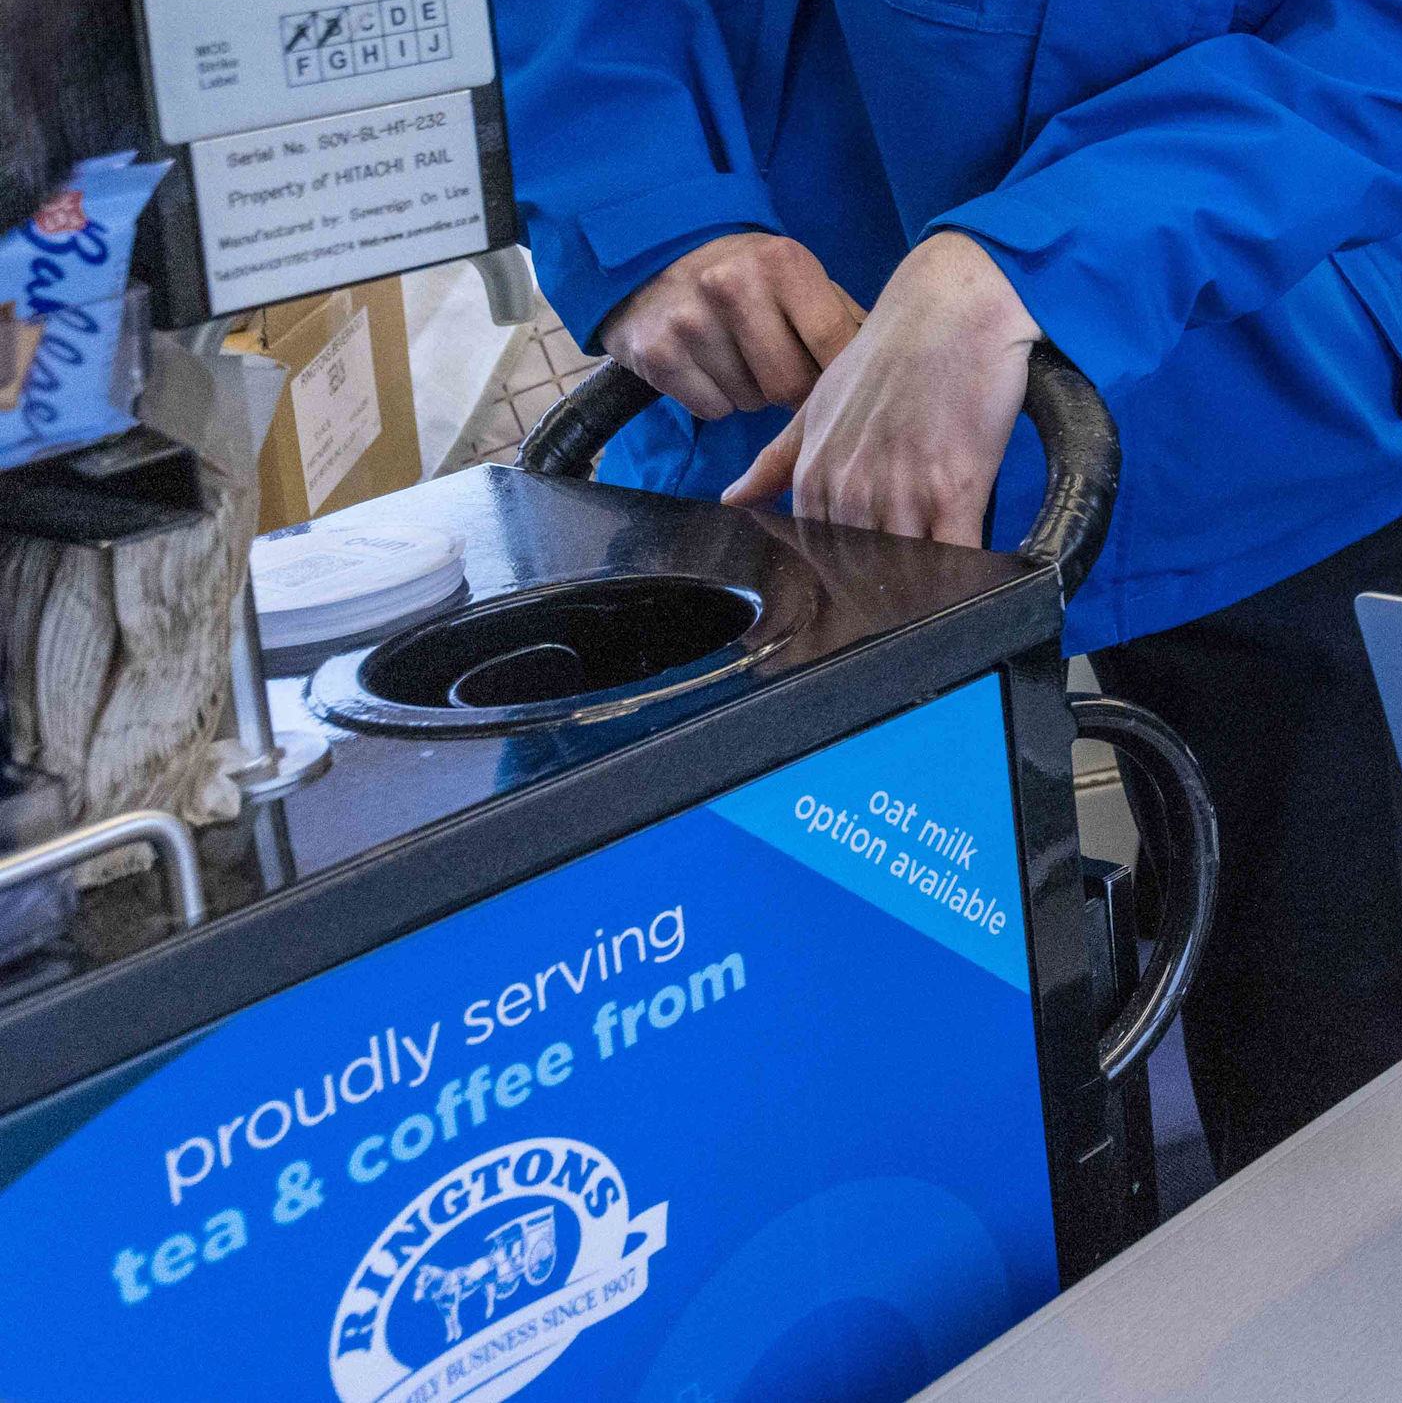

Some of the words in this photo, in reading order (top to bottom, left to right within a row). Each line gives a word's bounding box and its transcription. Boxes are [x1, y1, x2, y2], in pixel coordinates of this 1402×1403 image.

[296, 56, 311, 76] F
[328, 51, 347, 70] G
[362, 44, 379, 64] H
[399, 39, 407, 58] I
[428, 33, 440, 54] J
[358, 11, 376, 32] C
[390, 6, 407, 26] D
[422, 0, 438, 21] E
[226, 146, 276, 169] Serial
[228, 181, 306, 208] Property
[311, 171, 331, 191] of
[335, 158, 405, 186] HITACHI
[414, 149, 453, 169] RAIL
[218, 219, 316, 250] Manufactured
[349, 198, 414, 223] Sovereign
[445, 185, 471, 201] Line
[794, 795, 887, 865] option
[890, 852, 1006, 935] available
[869, 790, 918, 833] oat
[918, 819, 978, 871] milk
[165, 1021, 440, 1206] proudly
[463, 904, 685, 1045] serving
[111, 1207, 248, 1306] tea
[272, 1159, 325, 1224] &
[347, 1041, 574, 1183] coffee
[593, 952, 746, 1060] from
[336, 1148, 621, 1361] RINGTONS
[446, 1318, 539, 1384] BUSINESS
[542, 1288, 598, 1336] SINCE
[602, 1267, 636, 1303] 1907
